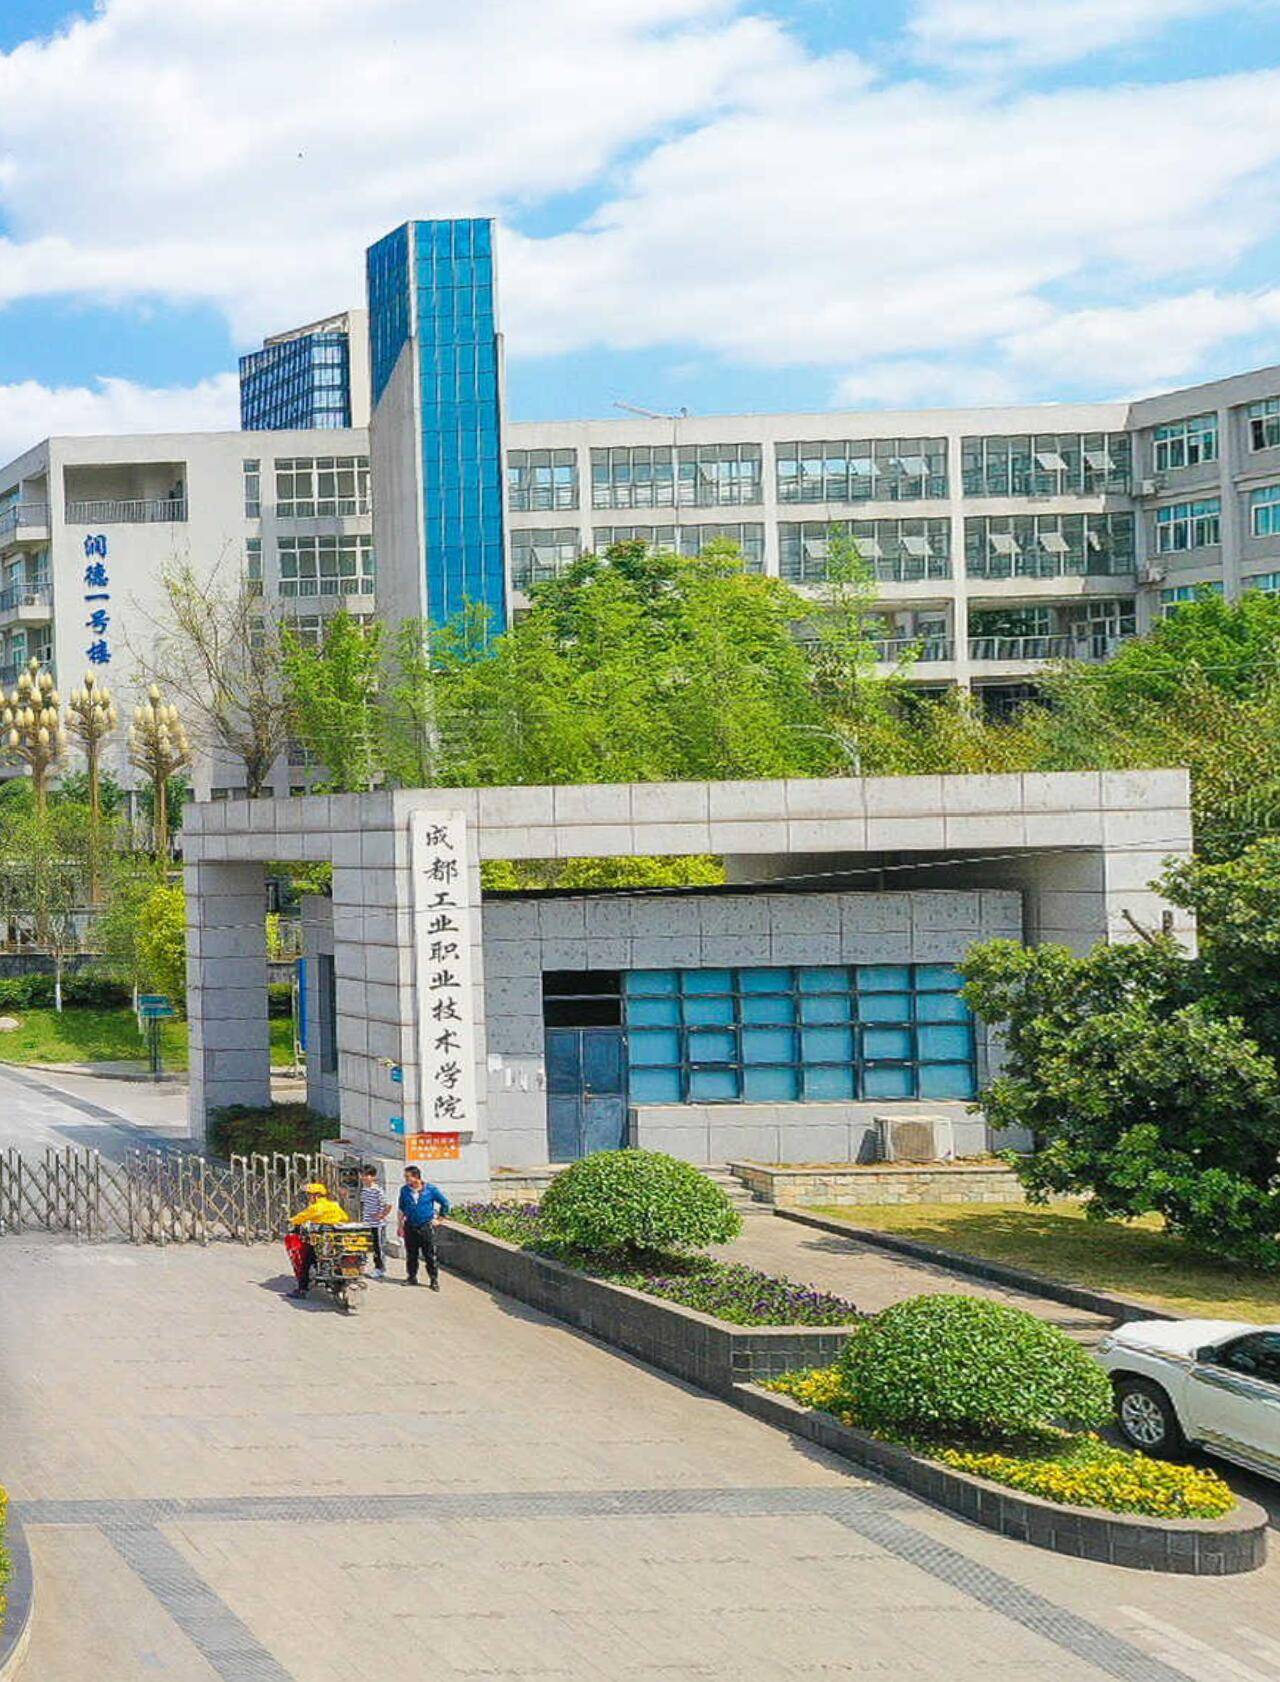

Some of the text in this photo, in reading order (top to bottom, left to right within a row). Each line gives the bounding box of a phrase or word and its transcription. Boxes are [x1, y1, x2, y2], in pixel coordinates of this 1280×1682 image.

[83, 534, 111, 664] 润德一号楼
[423, 824, 465, 1120] 成都工业职业技术学院
